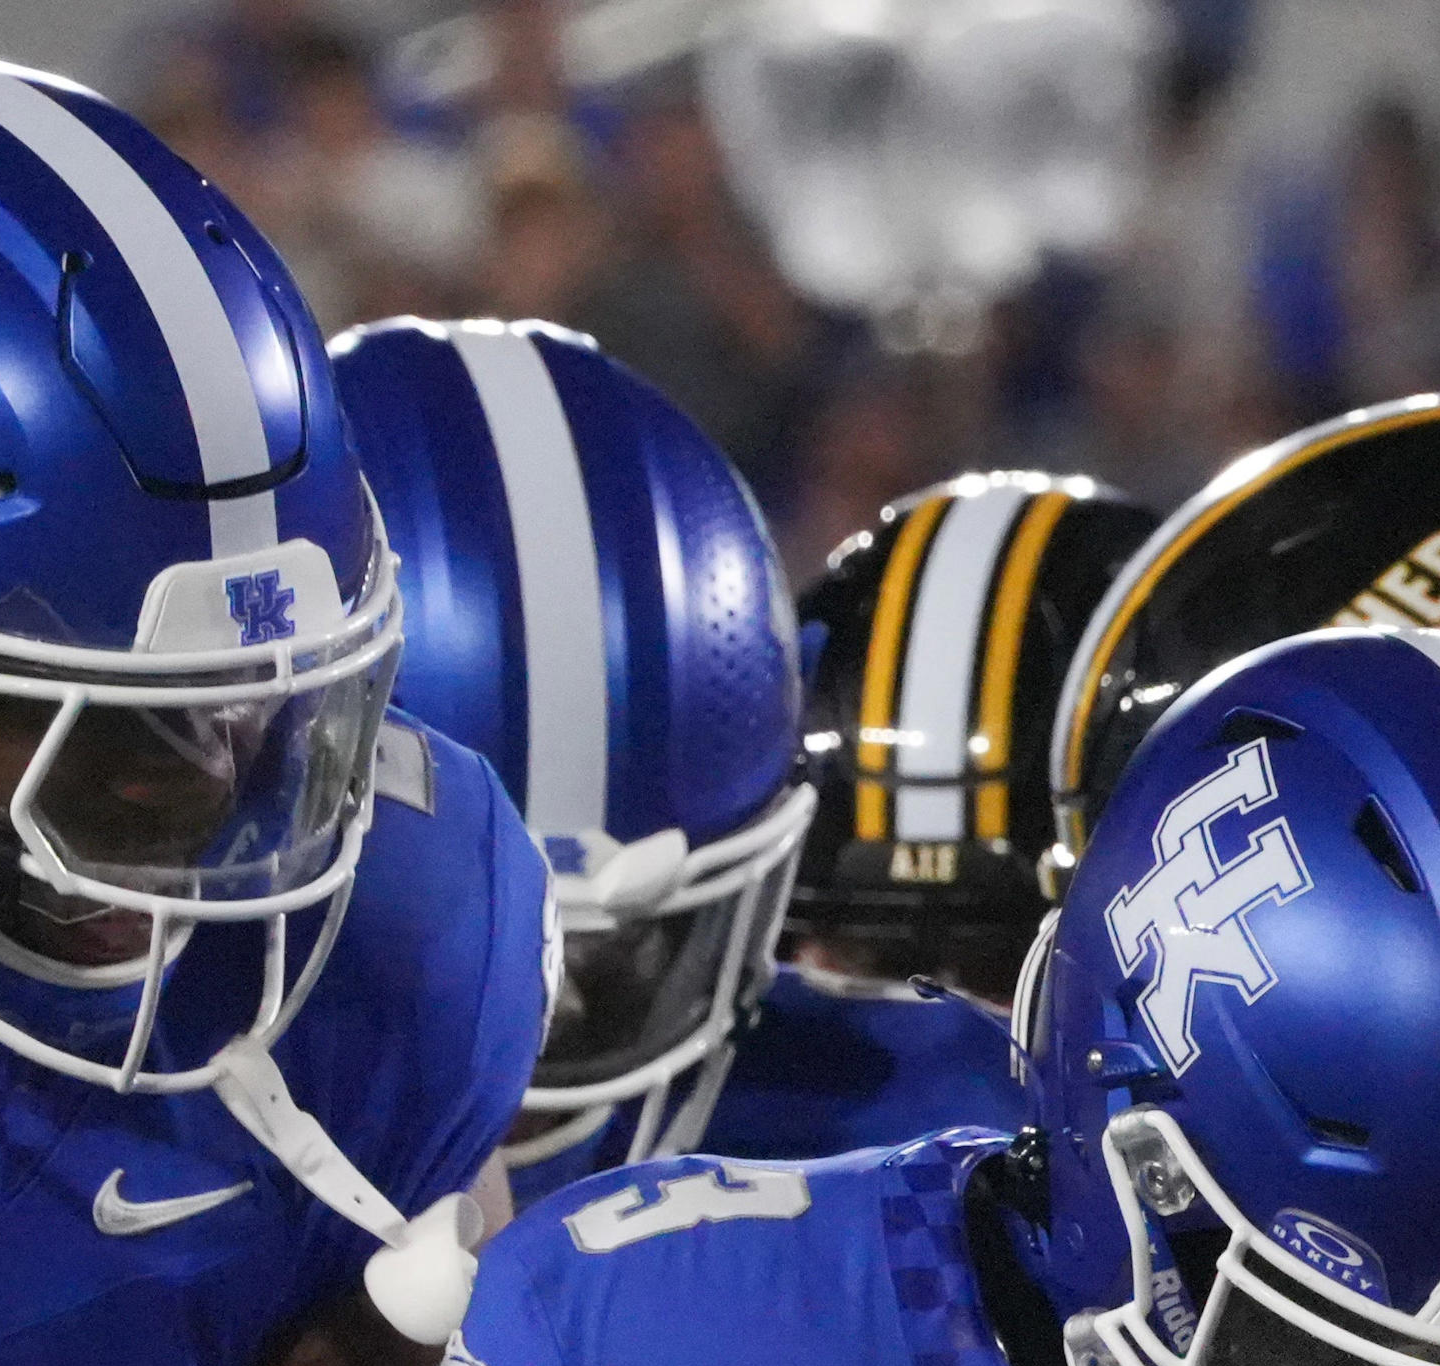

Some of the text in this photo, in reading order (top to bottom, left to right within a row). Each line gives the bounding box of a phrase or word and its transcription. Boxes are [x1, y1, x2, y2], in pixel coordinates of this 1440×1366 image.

[225, 570, 295, 647] UK
[1104, 737, 1313, 1080] UK
[563, 1161, 811, 1255] 3
[1272, 1223, 1374, 1291] OAKLEY
[1151, 1267, 1197, 1353] Ridd
